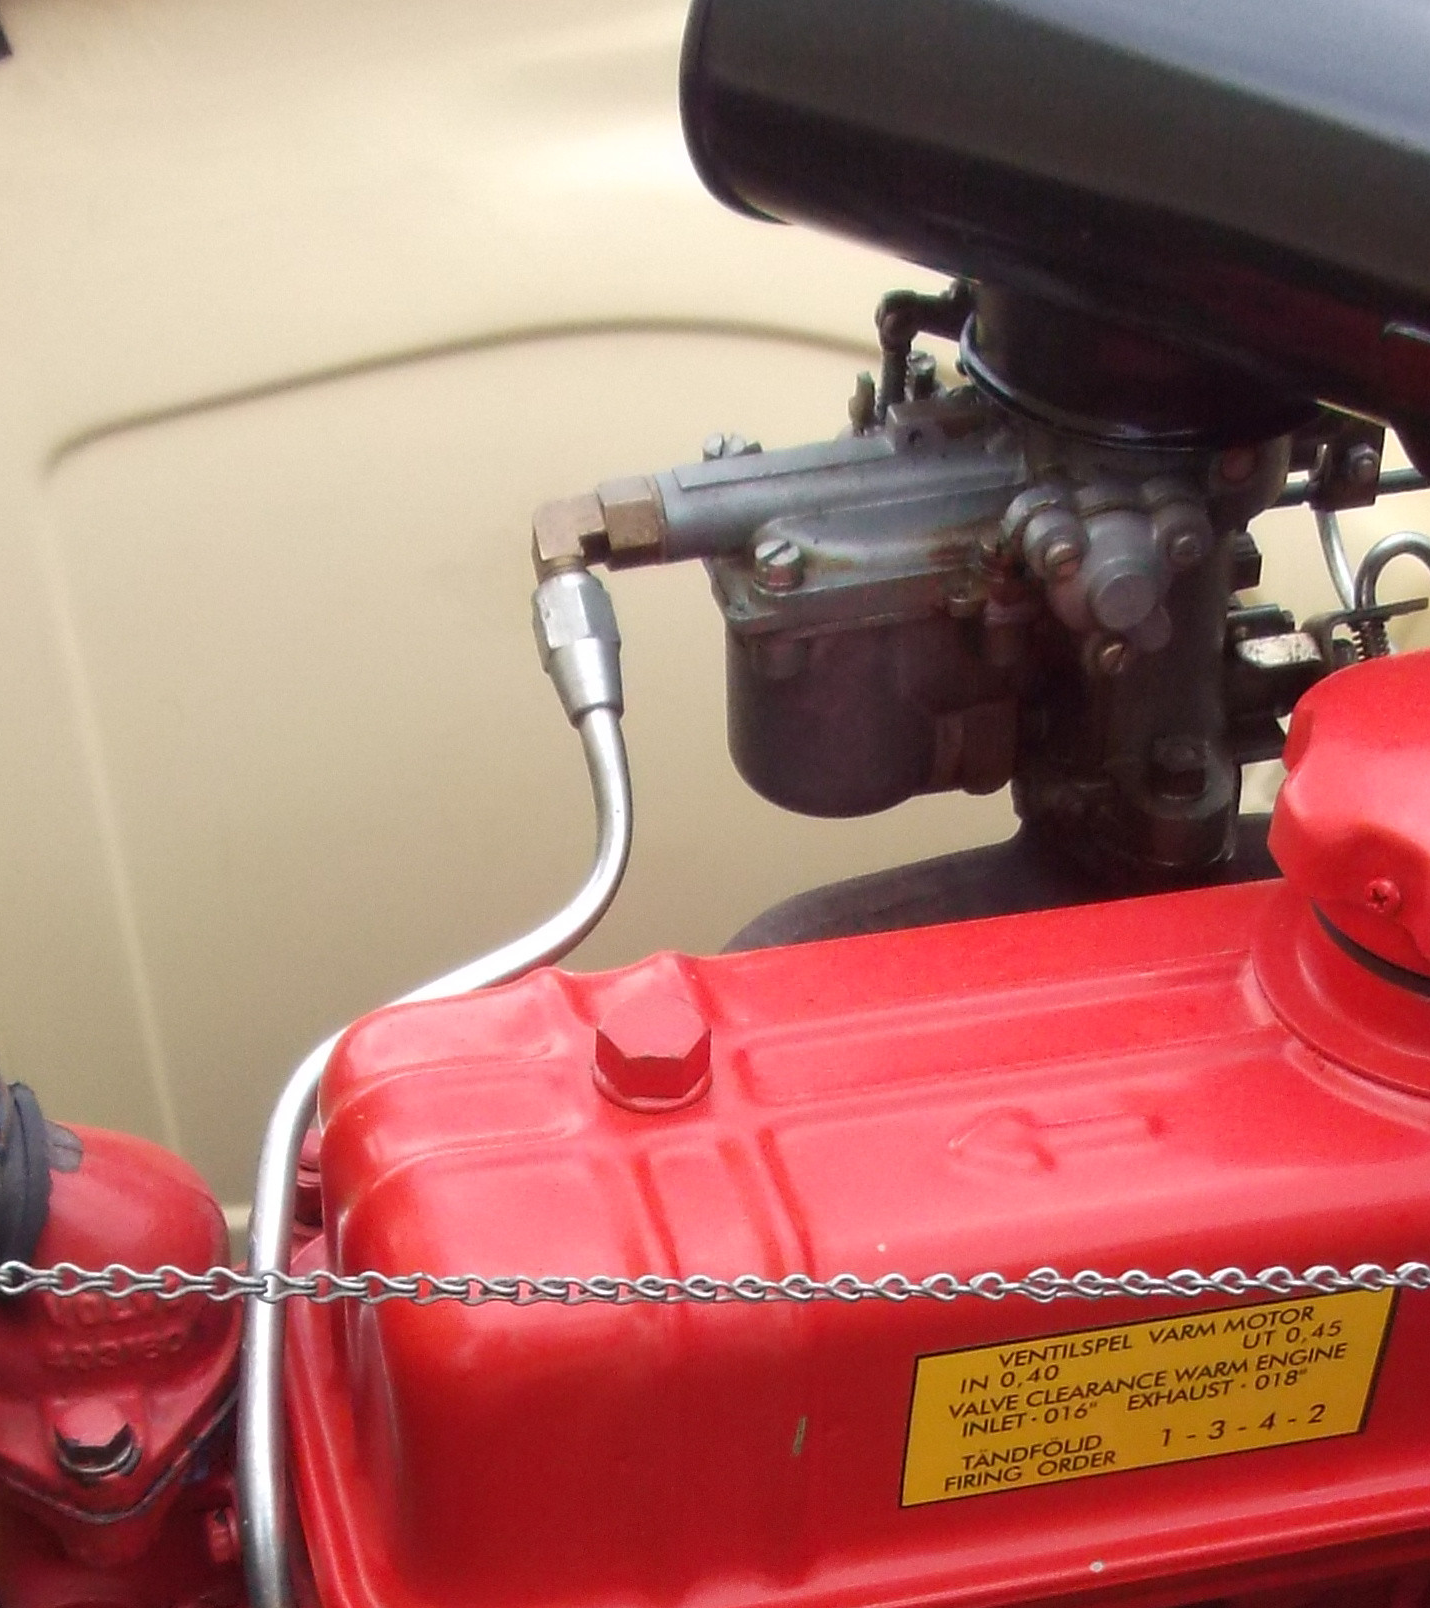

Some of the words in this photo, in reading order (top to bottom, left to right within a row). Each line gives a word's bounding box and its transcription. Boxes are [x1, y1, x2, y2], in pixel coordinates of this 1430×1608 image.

[960, 1374, 989, 1394] IN
[1000, 1364, 1060, 1388] 0,40
[1242, 1329, 1276, 1350] UT
[1285, 1319, 1343, 1344] 0,45
[998, 1333, 1133, 1368] VENTILSPEL
[1149, 1321, 1216, 1345] VARM
[1223, 1305, 1315, 1334] MOTOR
[948, 1394, 1019, 1419] VALVE
[1025, 1371, 1167, 1408] CLEARANCE
[1174, 1357, 1249, 1382] WARM
[1254, 1342, 1348, 1371] ENGINE
[1126, 1378, 1235, 1412] EXHAUST
[944, 1465, 1022, 1492] FIRING
[1036, 1450, 1117, 1477] ORDER
[961, 1435, 1103, 1471] TÄNDFÖLJD
